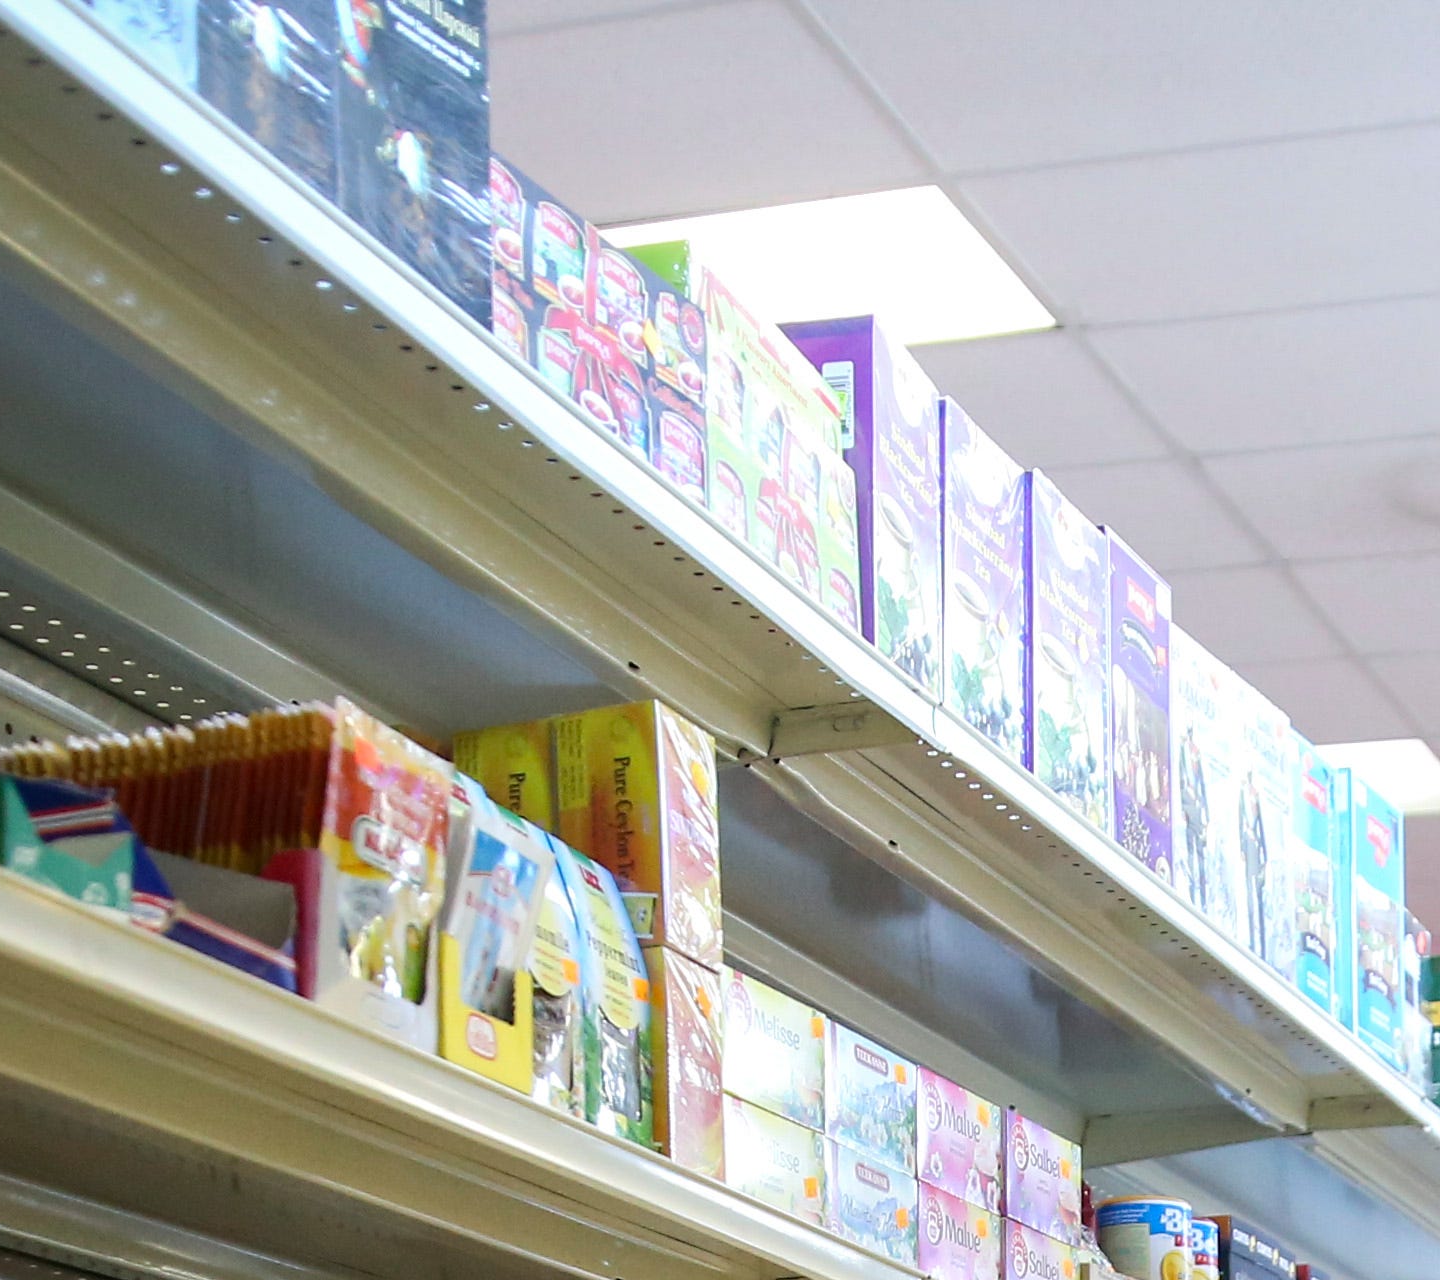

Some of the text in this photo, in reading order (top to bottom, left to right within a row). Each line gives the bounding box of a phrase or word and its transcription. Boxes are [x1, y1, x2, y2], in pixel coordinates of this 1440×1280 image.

[508, 772, 527, 812] Pure
[612, 756, 631, 796] Pure
[614, 800, 634, 857] Ceylon
[753, 1006, 802, 1052] Melisse
[942, 1104, 982, 1145] Malve
[1029, 1143, 1061, 1178] Salbei
[943, 1212, 983, 1255] Malve
